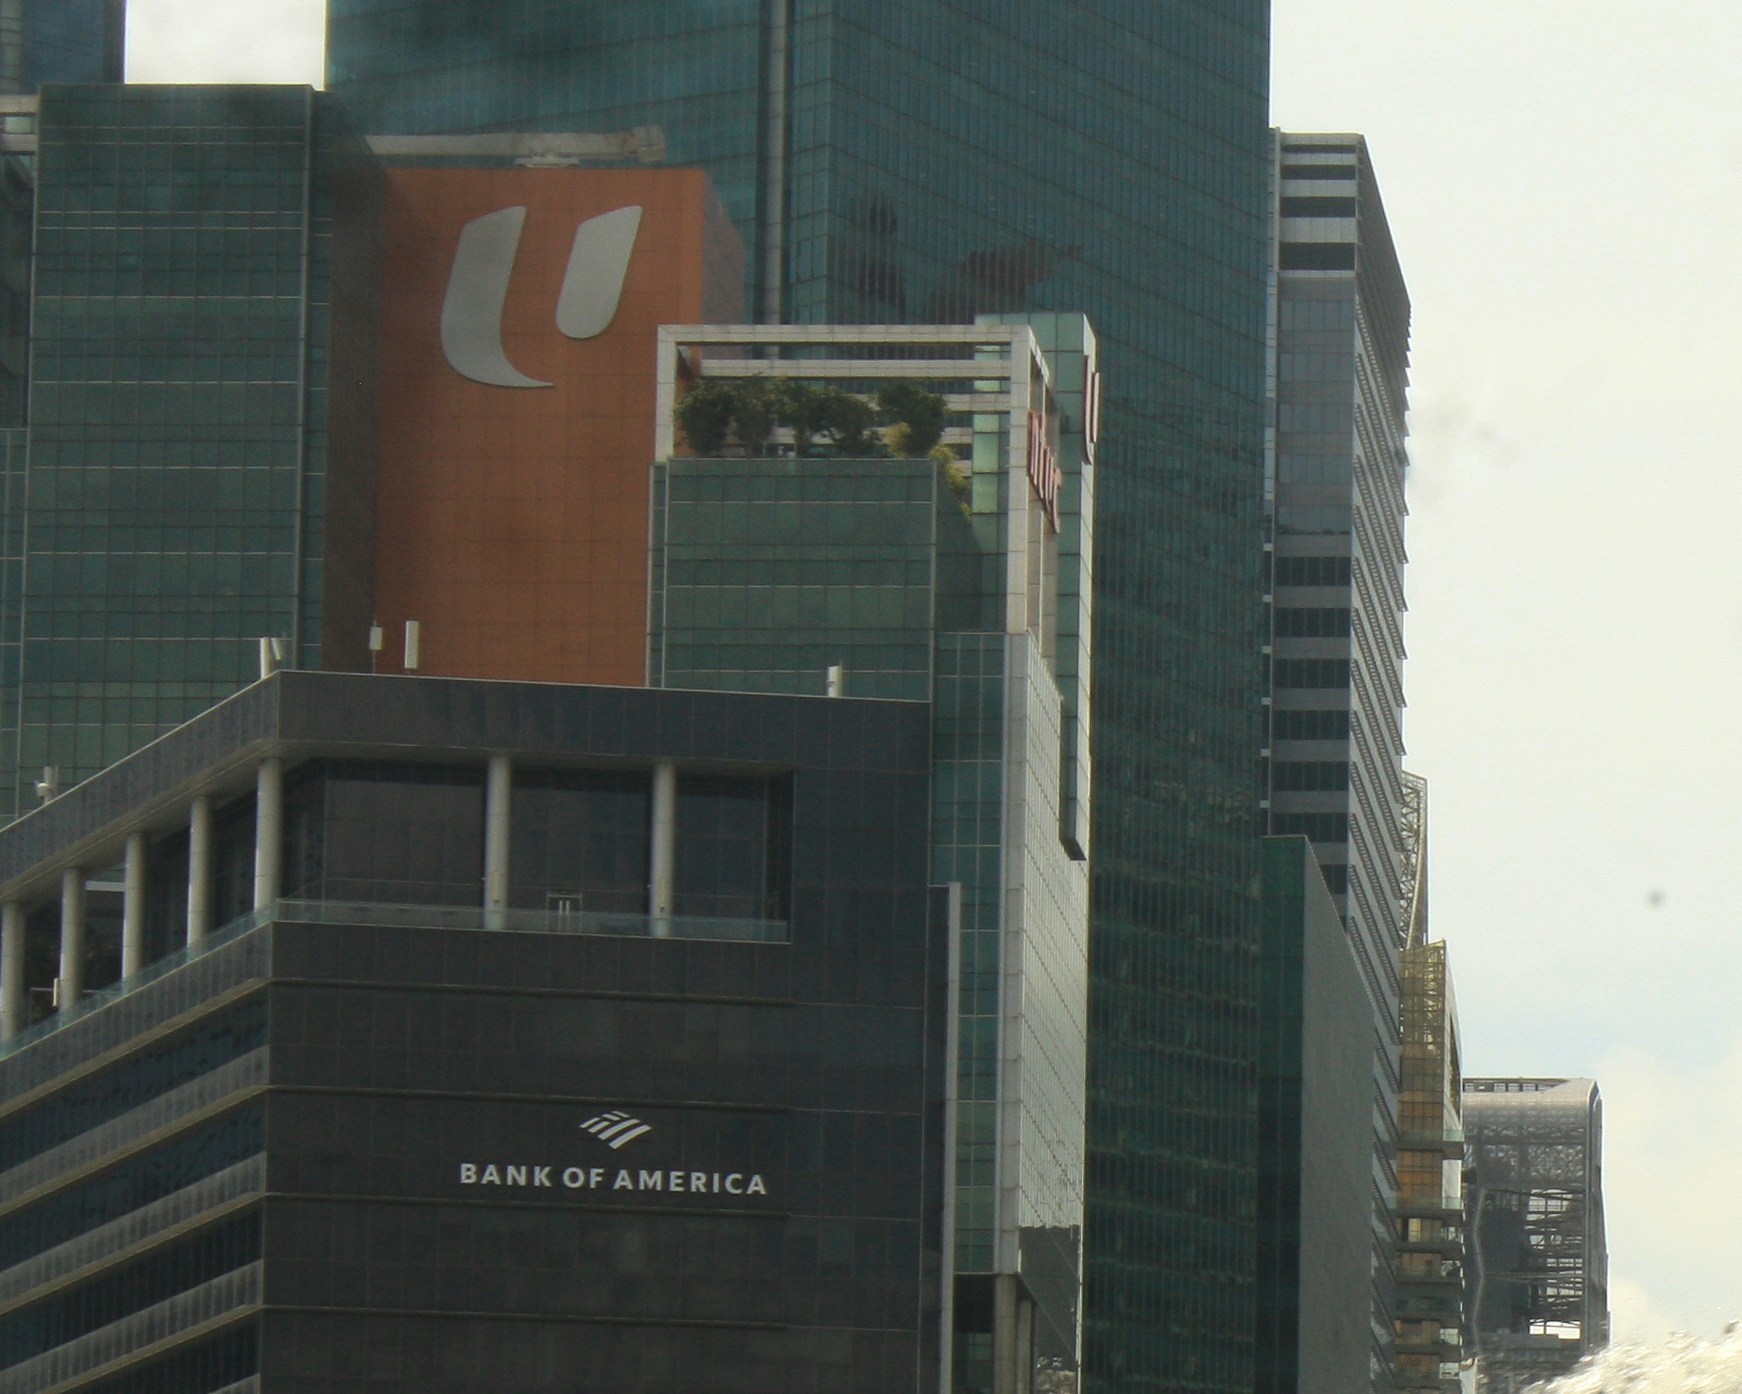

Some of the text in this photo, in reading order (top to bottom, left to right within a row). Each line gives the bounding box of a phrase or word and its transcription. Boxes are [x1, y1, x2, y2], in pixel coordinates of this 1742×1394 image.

[460, 1163, 767, 1195] BANK OF AMERICA
